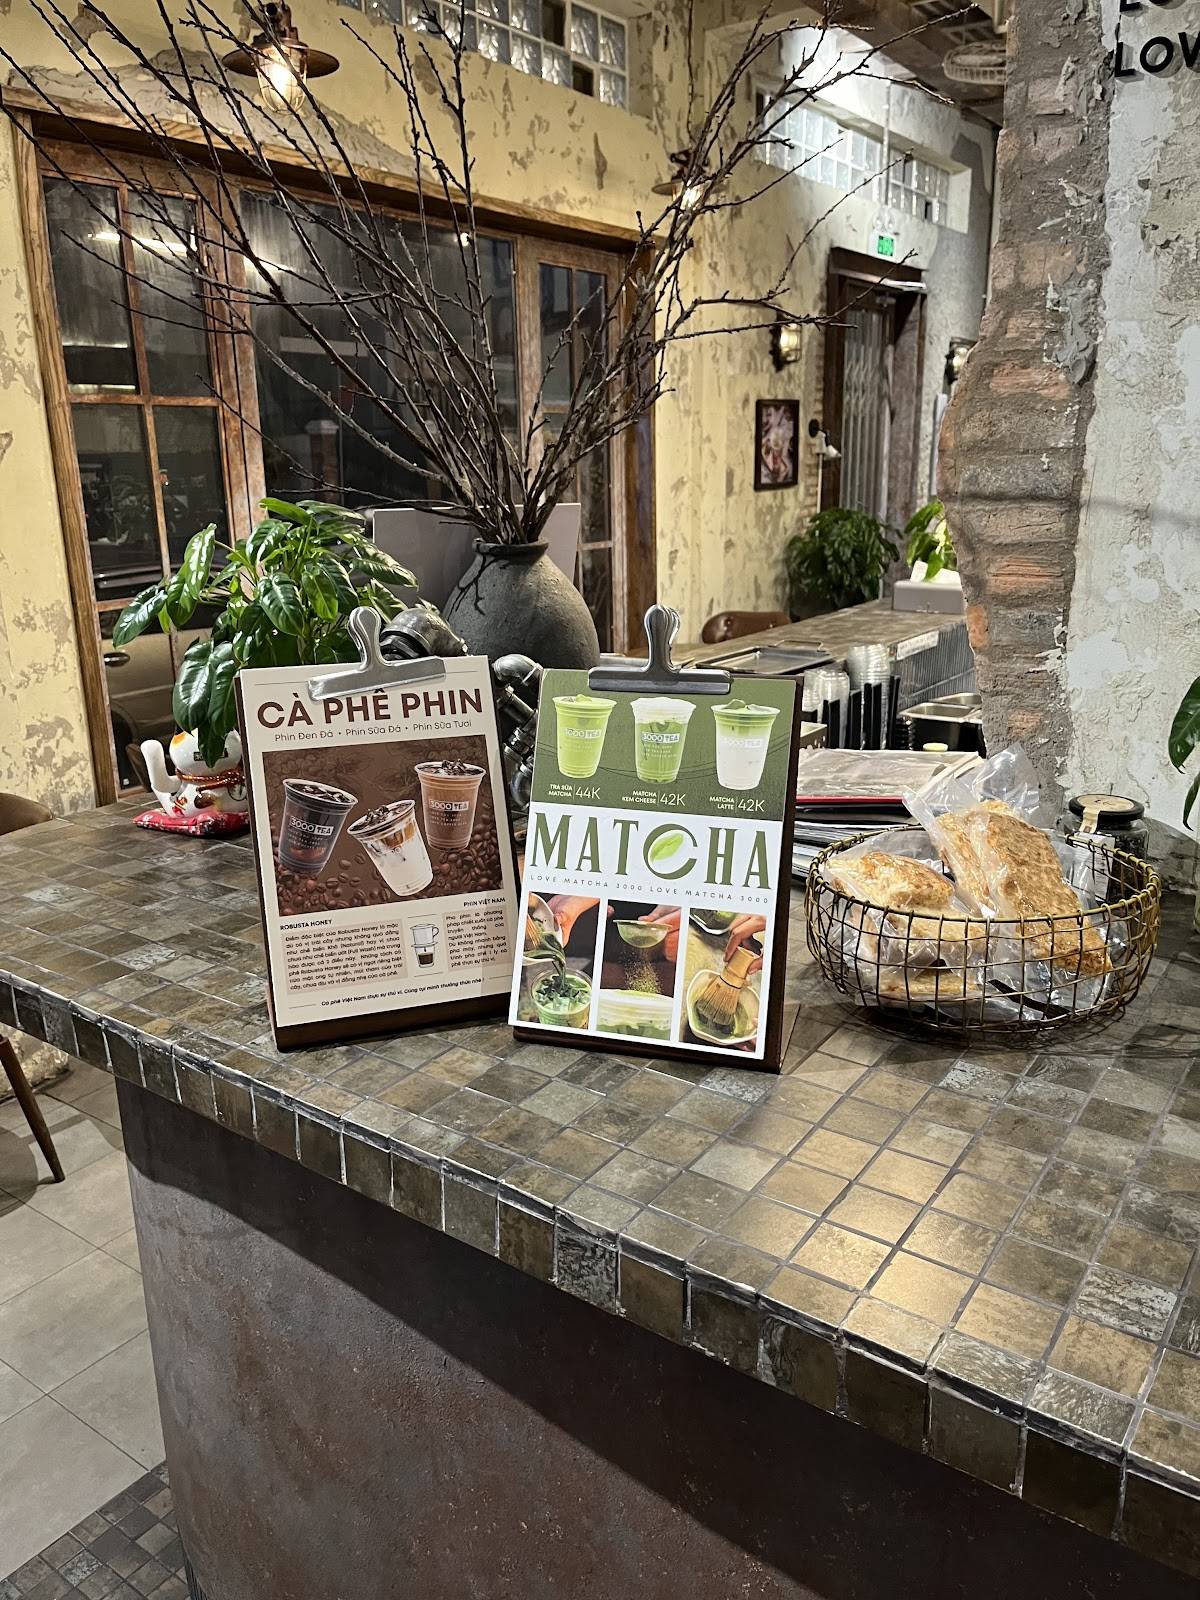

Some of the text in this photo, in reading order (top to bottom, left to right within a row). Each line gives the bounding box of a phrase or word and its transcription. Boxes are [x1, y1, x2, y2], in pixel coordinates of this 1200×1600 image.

[1115, 31, 1200, 77] LOV
[258, 688, 483, 728] CÀ PHÊ PHIN
[274, 733, 296, 741] Phin
[320, 730, 334, 738] Đá
[346, 728, 366, 736] Phin
[368, 726, 386, 734] Sữa
[388, 724, 401, 733] Đá
[413, 722, 432, 731] Phin
[434, 720, 452, 730] Sữa
[453, 719, 472, 728] Tươi
[575, 786, 600, 800] 44K
[660, 794, 686, 806] 42K
[738, 799, 765, 812] 42K
[290, 816, 332, 834] 3000 TEA
[530, 812, 771, 890] MATCHA
[564, 878, 608, 888] MATCHA
[650, 886, 677, 894] LOVE
[686, 890, 732, 900] MATCHA
